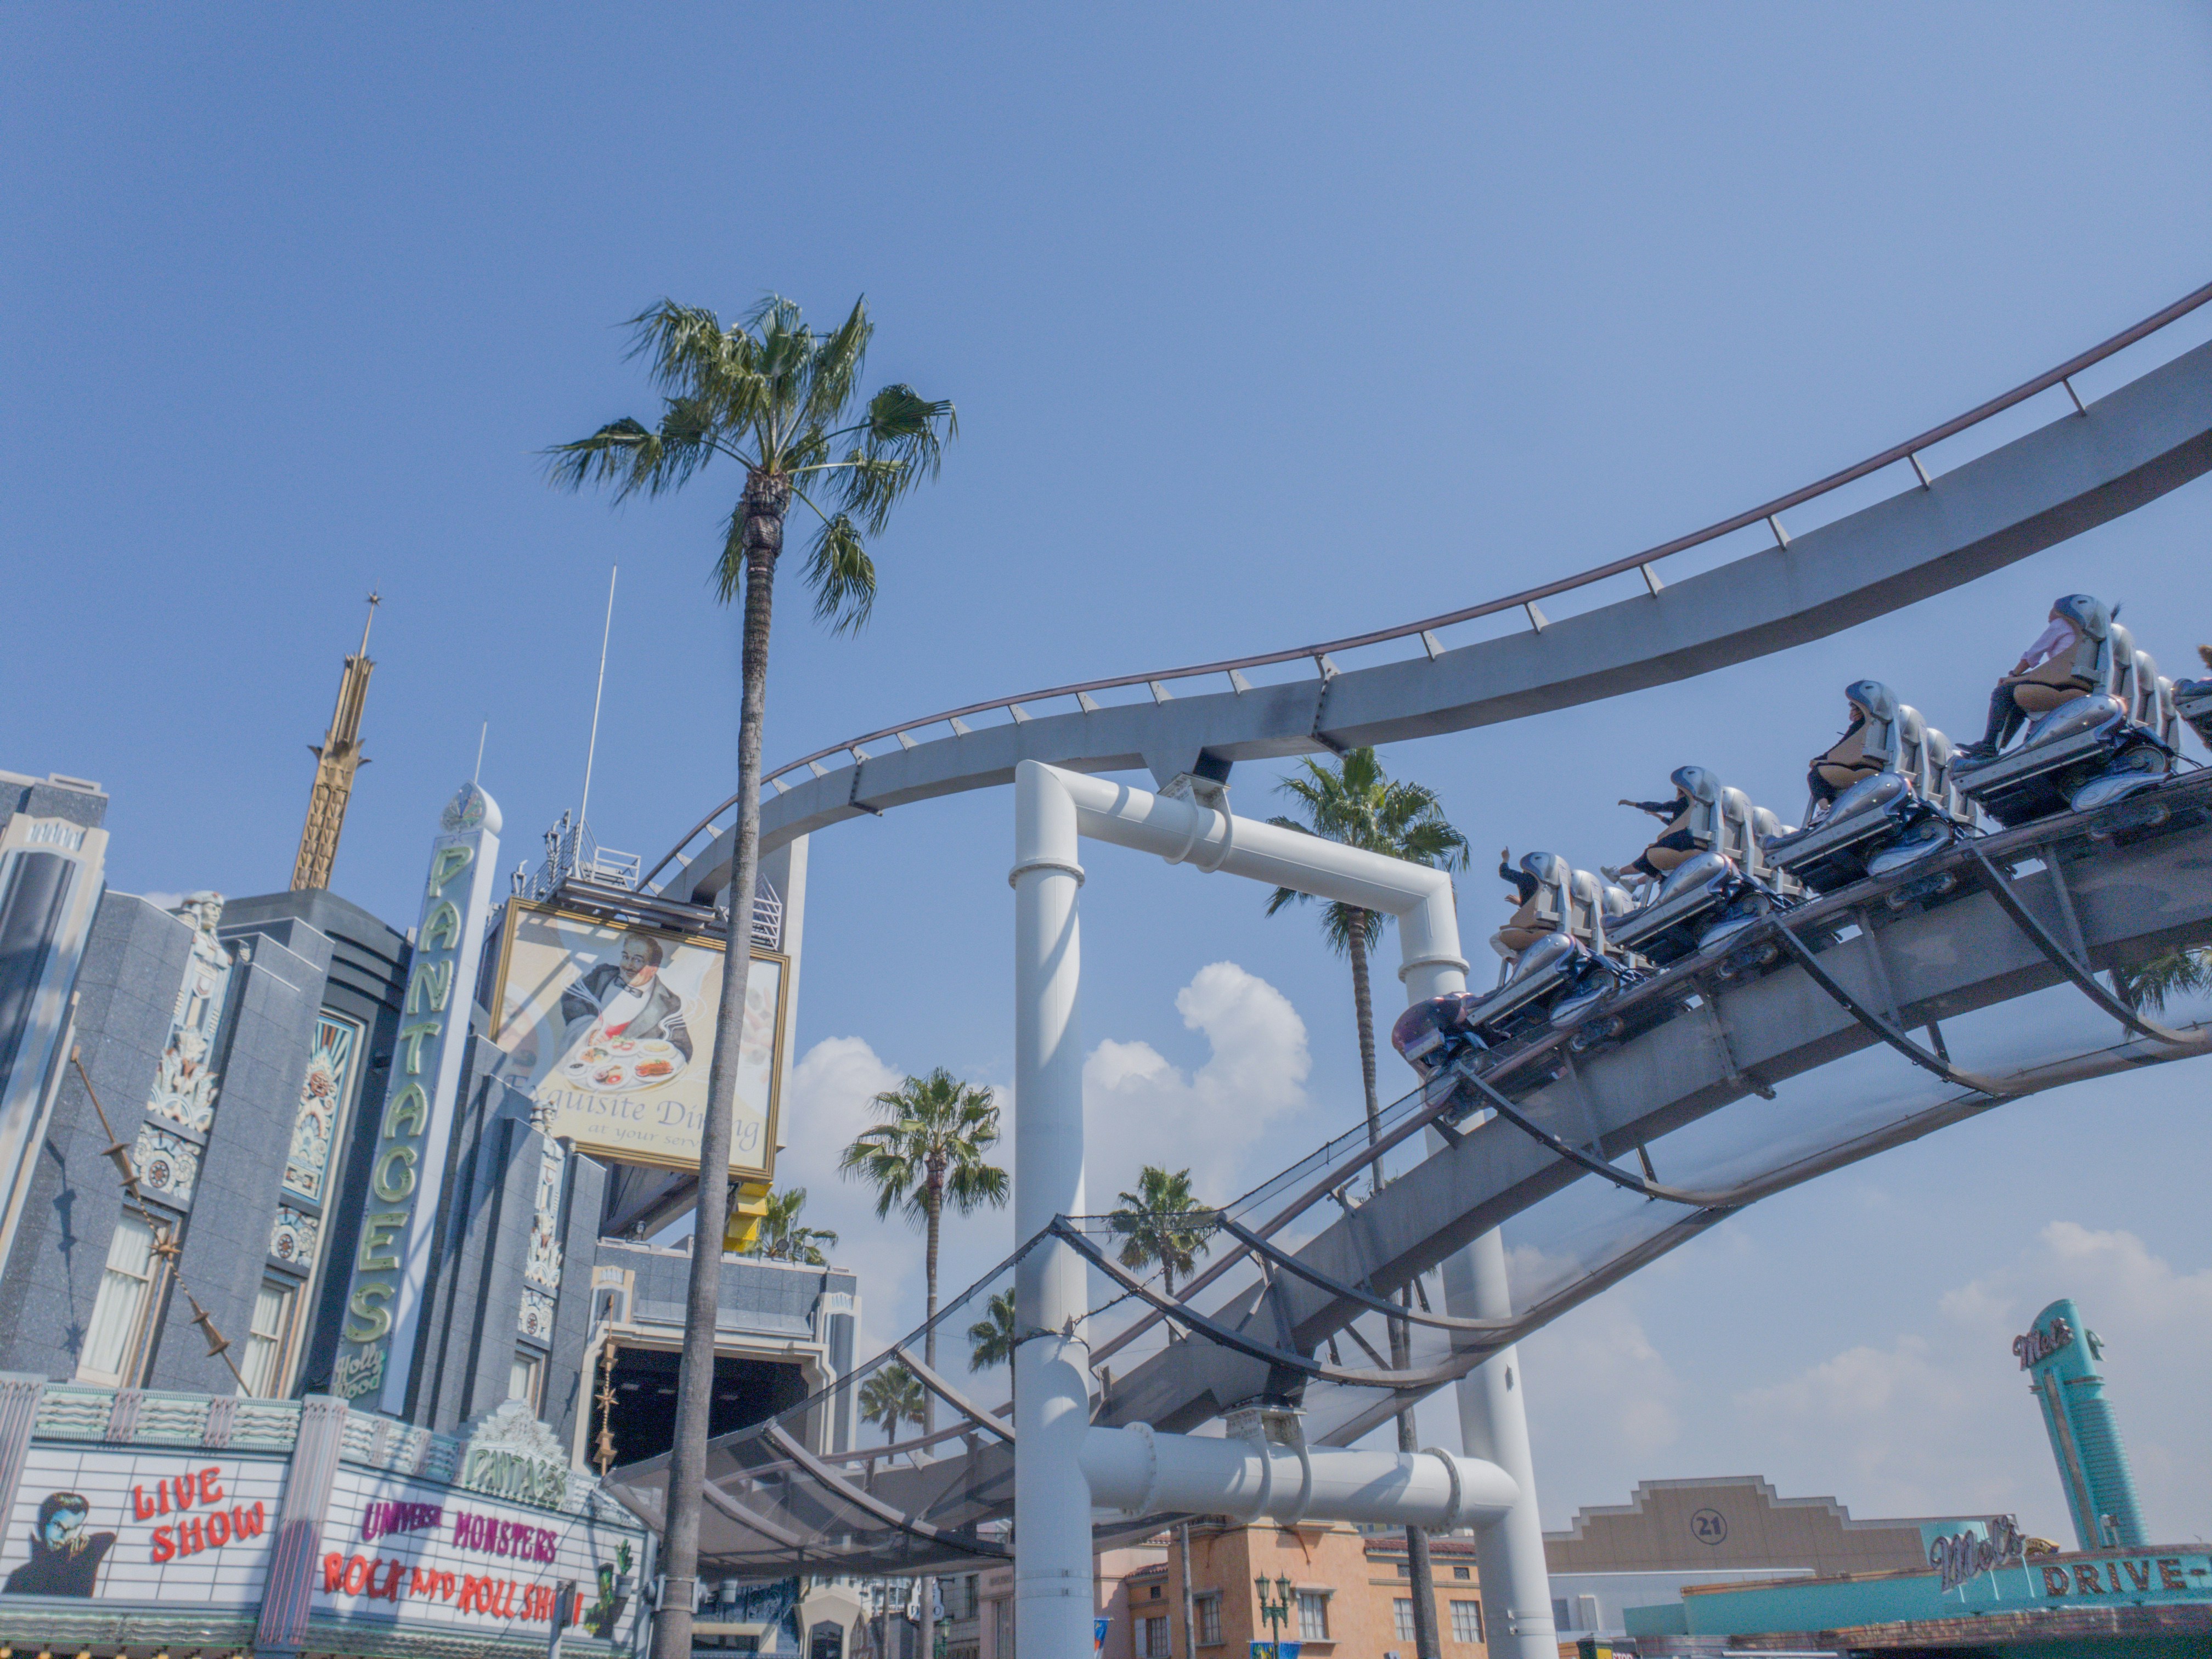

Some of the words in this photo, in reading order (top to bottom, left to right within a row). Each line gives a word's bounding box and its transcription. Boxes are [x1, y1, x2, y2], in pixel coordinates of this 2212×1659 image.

[345, 846, 474, 1343] PANTAGES
[588, 1124, 607, 1134] at
[612, 1127, 659, 1143] your
[657, 1100, 759, 1152] Ding
[331, 1342, 386, 1384] Holly
[133, 1466, 225, 1521] LIVE
[466, 1449, 568, 1504] PANTAGES
[152, 1501, 265, 1562] SHOW
[452, 1510, 558, 1564] MONSTERS
[1696, 1516, 1721, 1536] 21
[323, 1551, 407, 1601] ROCK
[409, 1566, 455, 1600] AND
[458, 1573, 516, 1619] ROLL
[521, 1582, 584, 1626] SH
[2042, 1557, 2212, 1597] DRIVE-
